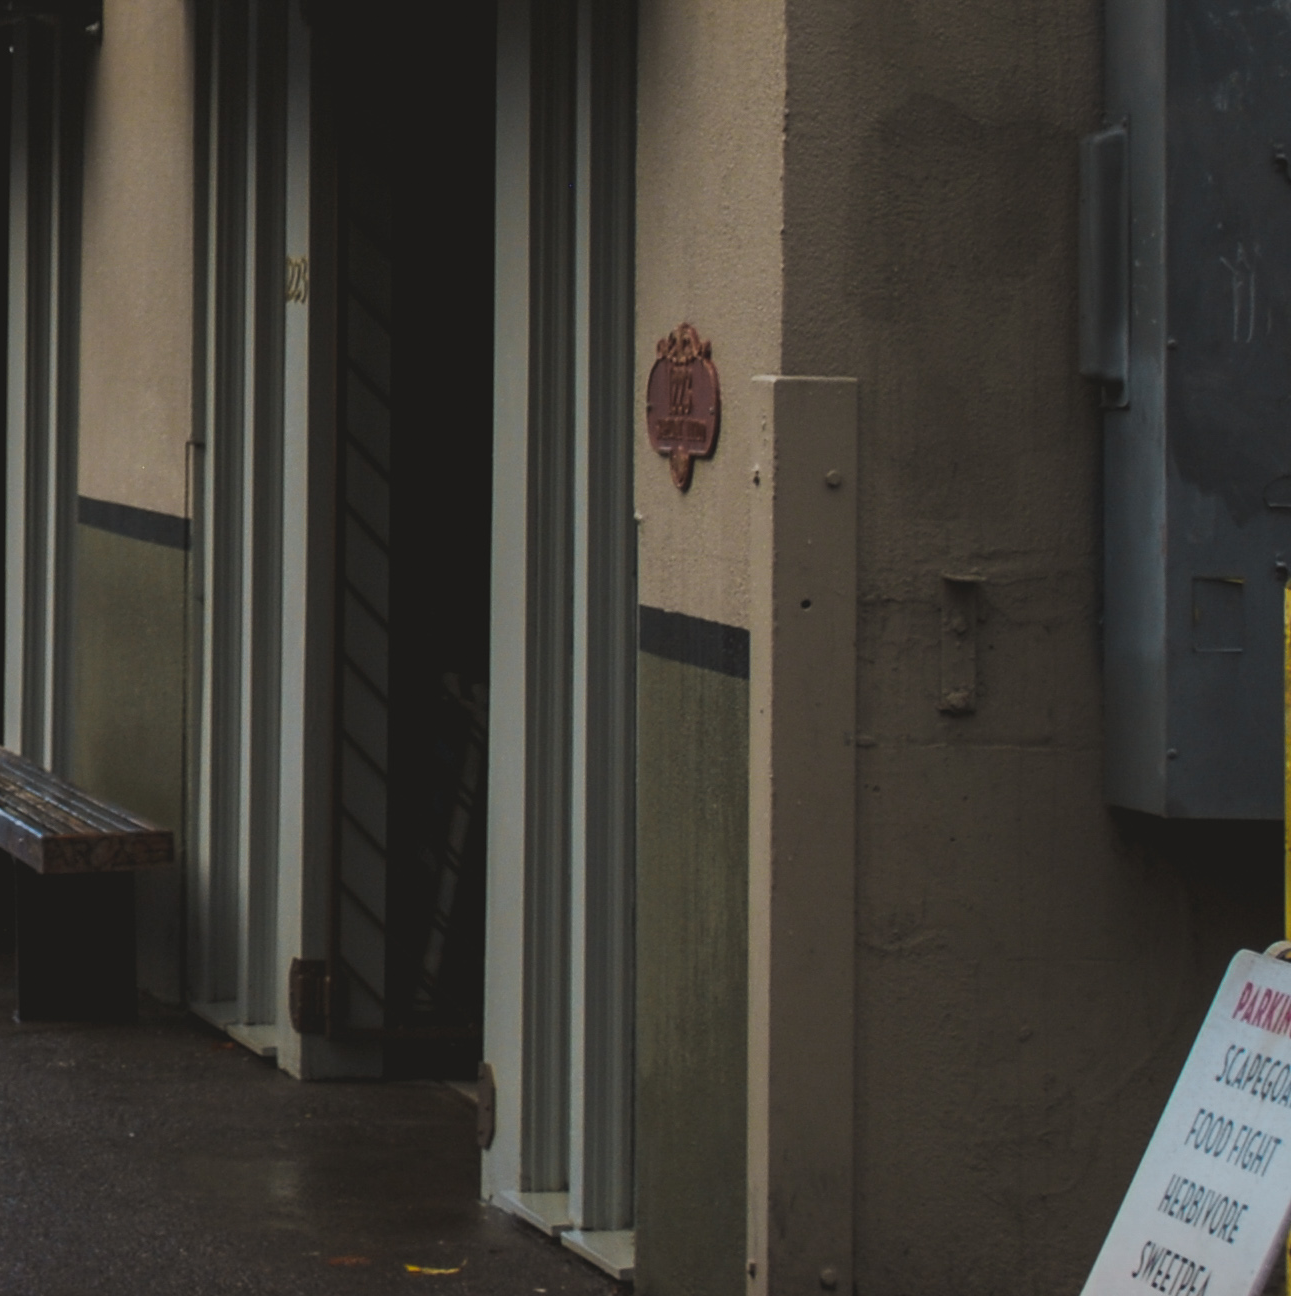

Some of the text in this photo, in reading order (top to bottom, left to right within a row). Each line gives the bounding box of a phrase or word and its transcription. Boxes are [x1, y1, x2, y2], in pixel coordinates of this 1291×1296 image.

[1184, 1108, 1283, 1177] FOOD FIGHT
[1157, 1173, 1249, 1245] HERBIVORE
